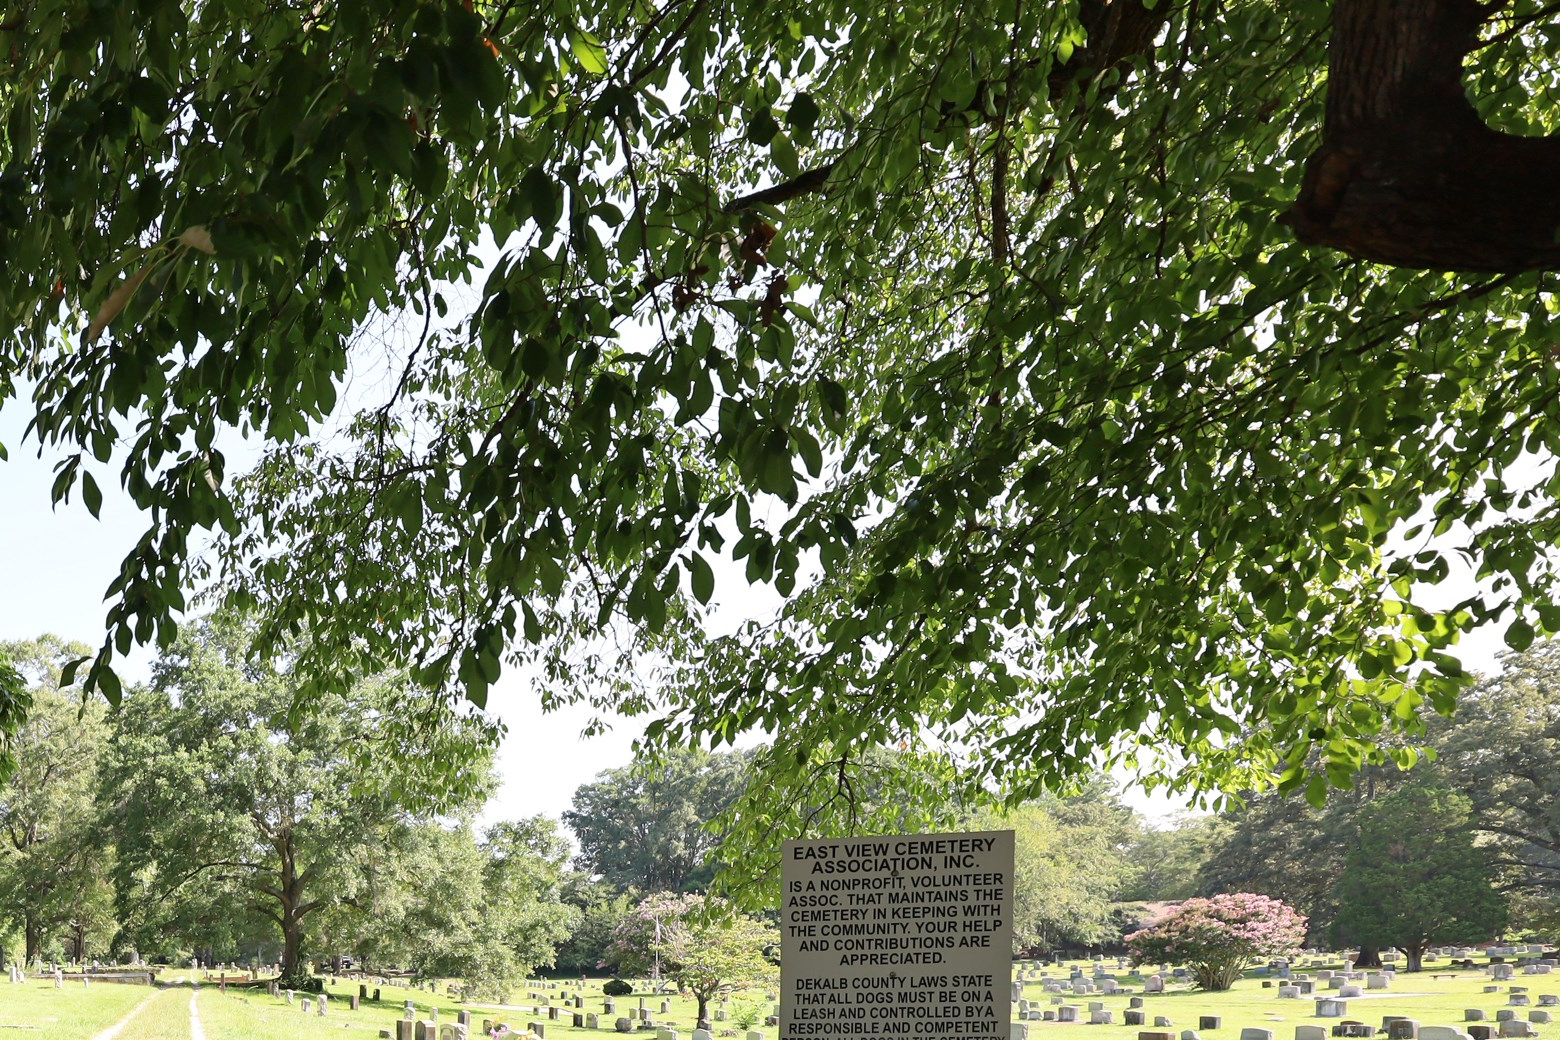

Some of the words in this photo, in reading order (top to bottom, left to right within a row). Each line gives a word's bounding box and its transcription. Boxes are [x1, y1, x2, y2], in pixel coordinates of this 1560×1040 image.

[794, 845, 839, 860] EAST
[844, 843, 889, 857] VIEW
[895, 838, 996, 855] CEMETERY
[811, 857, 937, 874] ASSOCIATION,
[944, 855, 979, 868] INC.
[790, 881, 802, 892] IS
[806, 880, 816, 892] A
[821, 877, 906, 891] NONPROFIT,
[911, 873, 1003, 888] VOLUNTEER
[789, 895, 842, 907] ASSOC.
[847, 893, 883, 905] THAT
[889, 890, 968, 904] MAINTAINS
[974, 888, 1003, 901] THE
[791, 909, 868, 922] CEMETERY
[873, 908, 886, 919] IN
[892, 906, 957, 919] KEEPING
[962, 904, 1000, 916] WITH
[788, 926, 816, 937] THE
[821, 922, 910, 936] COMMUNITY.
[915, 921, 957, 933] YOUR
[963, 920, 1002, 932] HELP
[799, 940, 829, 952] AND
[834, 936, 954, 950] CONTRIBUTIONS
[959, 936, 990, 948] ARE
[840, 952, 946, 966] APPRECIATED.
[796, 978, 848, 990] DEKALB
[852, 976, 906, 989] COUNTY
[911, 976, 947, 988] LAWS
[952, 975, 992, 987] STATE
[794, 994, 826, 1005] THAT
[828, 993, 852, 1004] ALL
[856, 992, 893, 1004] DOGS
[898, 992, 934, 1003] MUST
[939, 991, 956, 1002] BE
[961, 991, 980, 1002] ON
[984, 990, 994, 1002] A
[794, 1008, 835, 1019] LEASH
[839, 1008, 866, 1019] AND
[870, 1006, 960, 1018] CONTROLLED
[966, 1006, 983, 1017] BY
[985, 1006, 994, 1017] A
[789, 1022, 879, 1034] RESPONSIBLE
[882, 1022, 910, 1033] AND
[915, 1021, 998, 1033] COMPETENT
